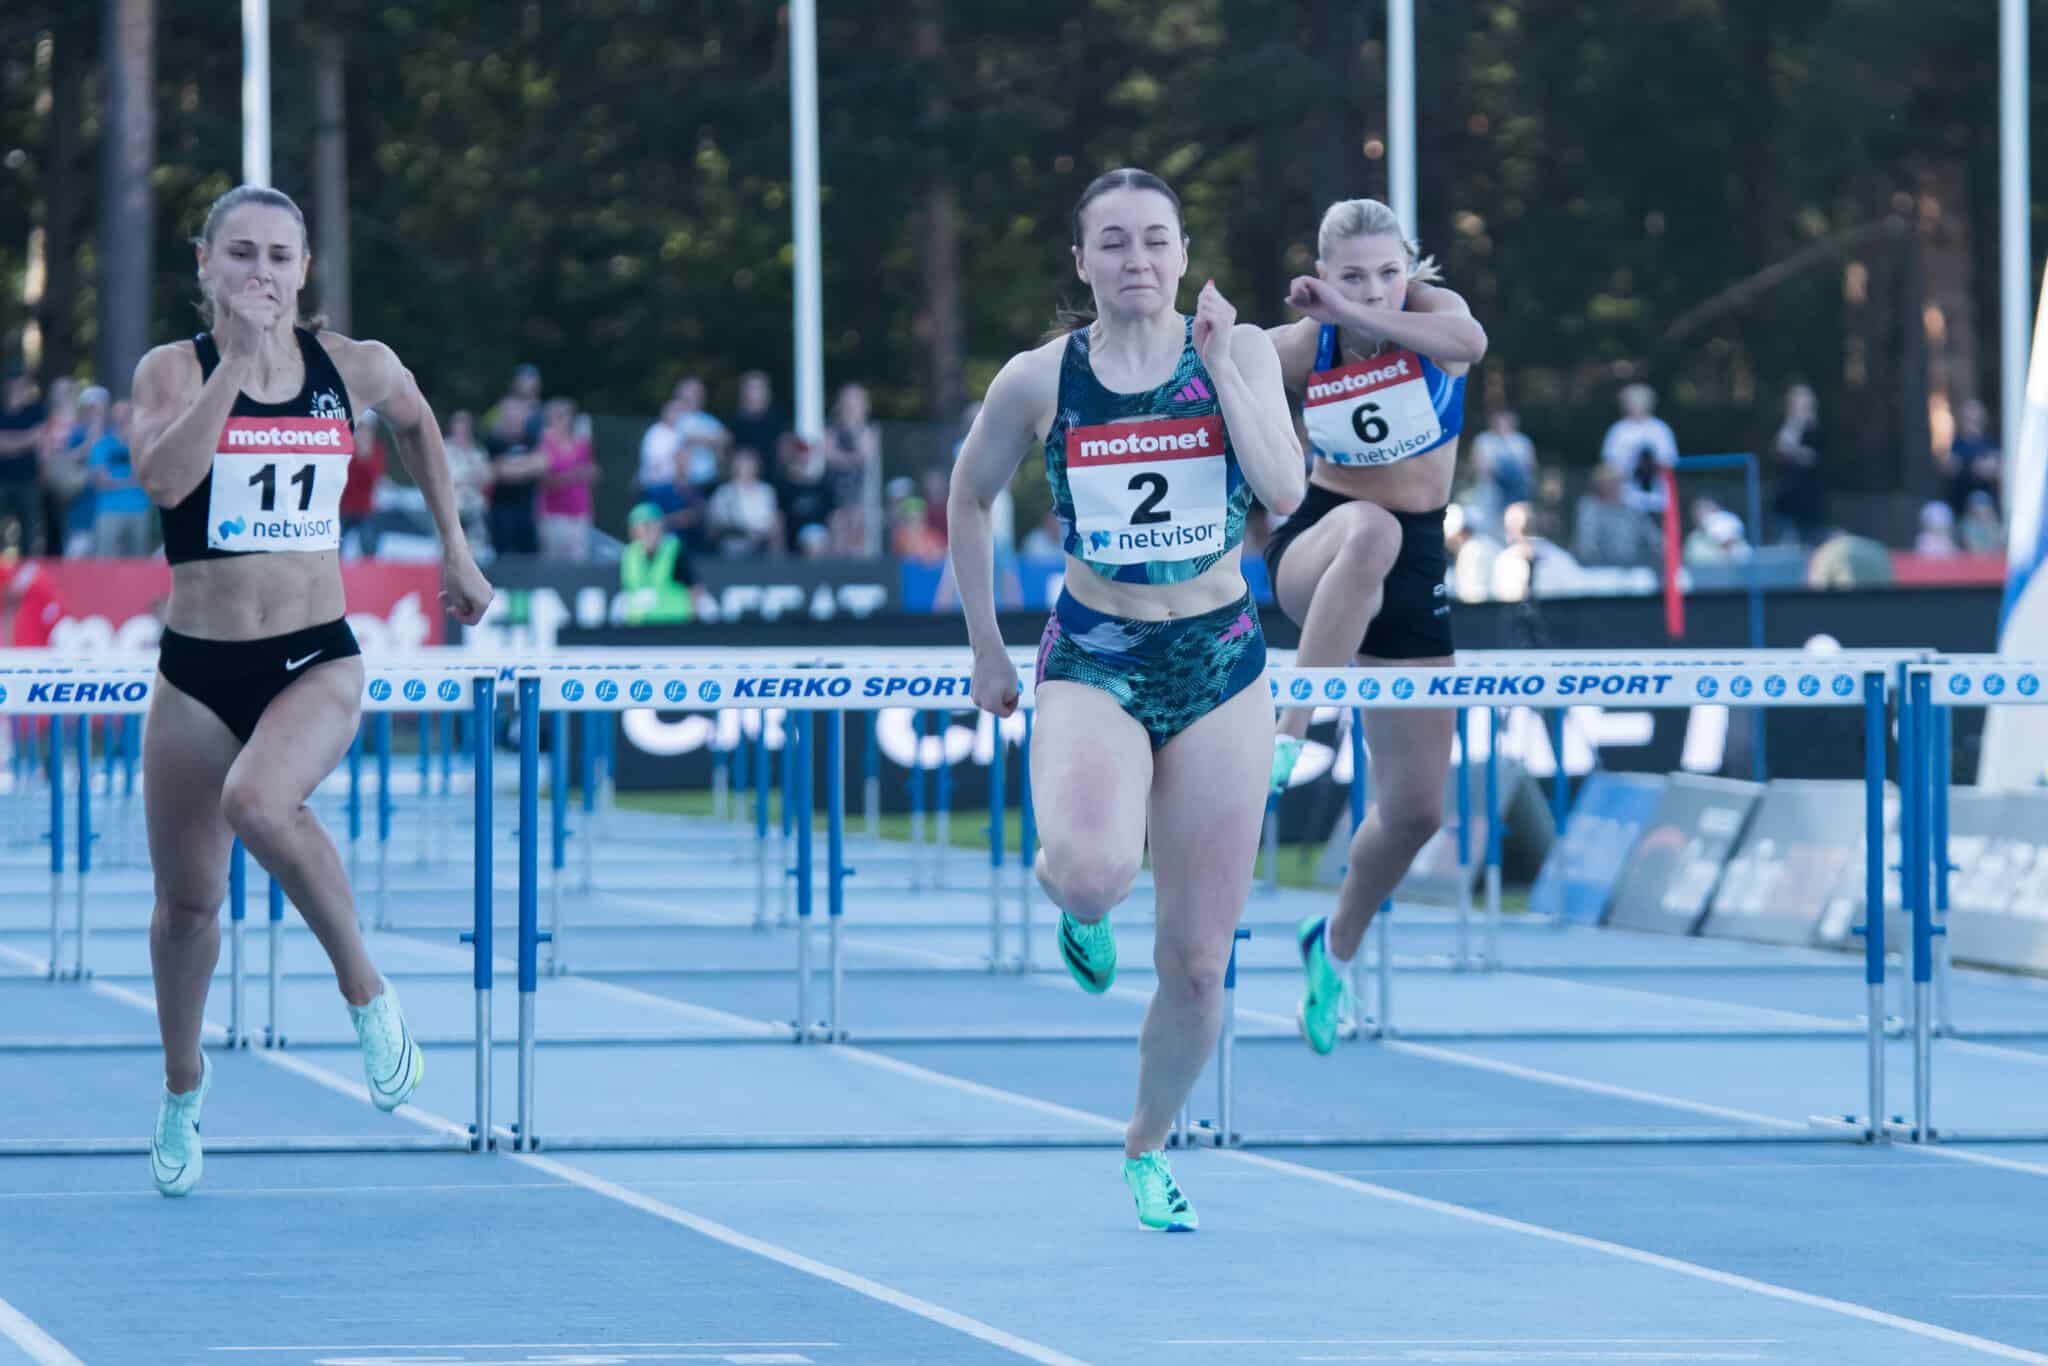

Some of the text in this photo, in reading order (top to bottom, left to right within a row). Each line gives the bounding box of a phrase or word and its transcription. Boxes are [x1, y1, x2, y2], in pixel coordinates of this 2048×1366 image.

[1307, 358, 1410, 399] motonet
[228, 427, 341, 447] motonet
[1352, 402, 1389, 444] 6
[1081, 427, 1209, 457] motonet
[1355, 431, 1431, 464] netvisor
[248, 463, 316, 512] 11
[1128, 472, 1171, 525] 2
[253, 516, 331, 538] netvisor
[1119, 523, 1216, 549] netvisor
[27, 682, 148, 702] KERKO
[734, 677, 852, 697] KERKO
[863, 676, 972, 697] SPORT
[1428, 676, 1546, 696] KERKO
[1556, 675, 1672, 695] SPORT
